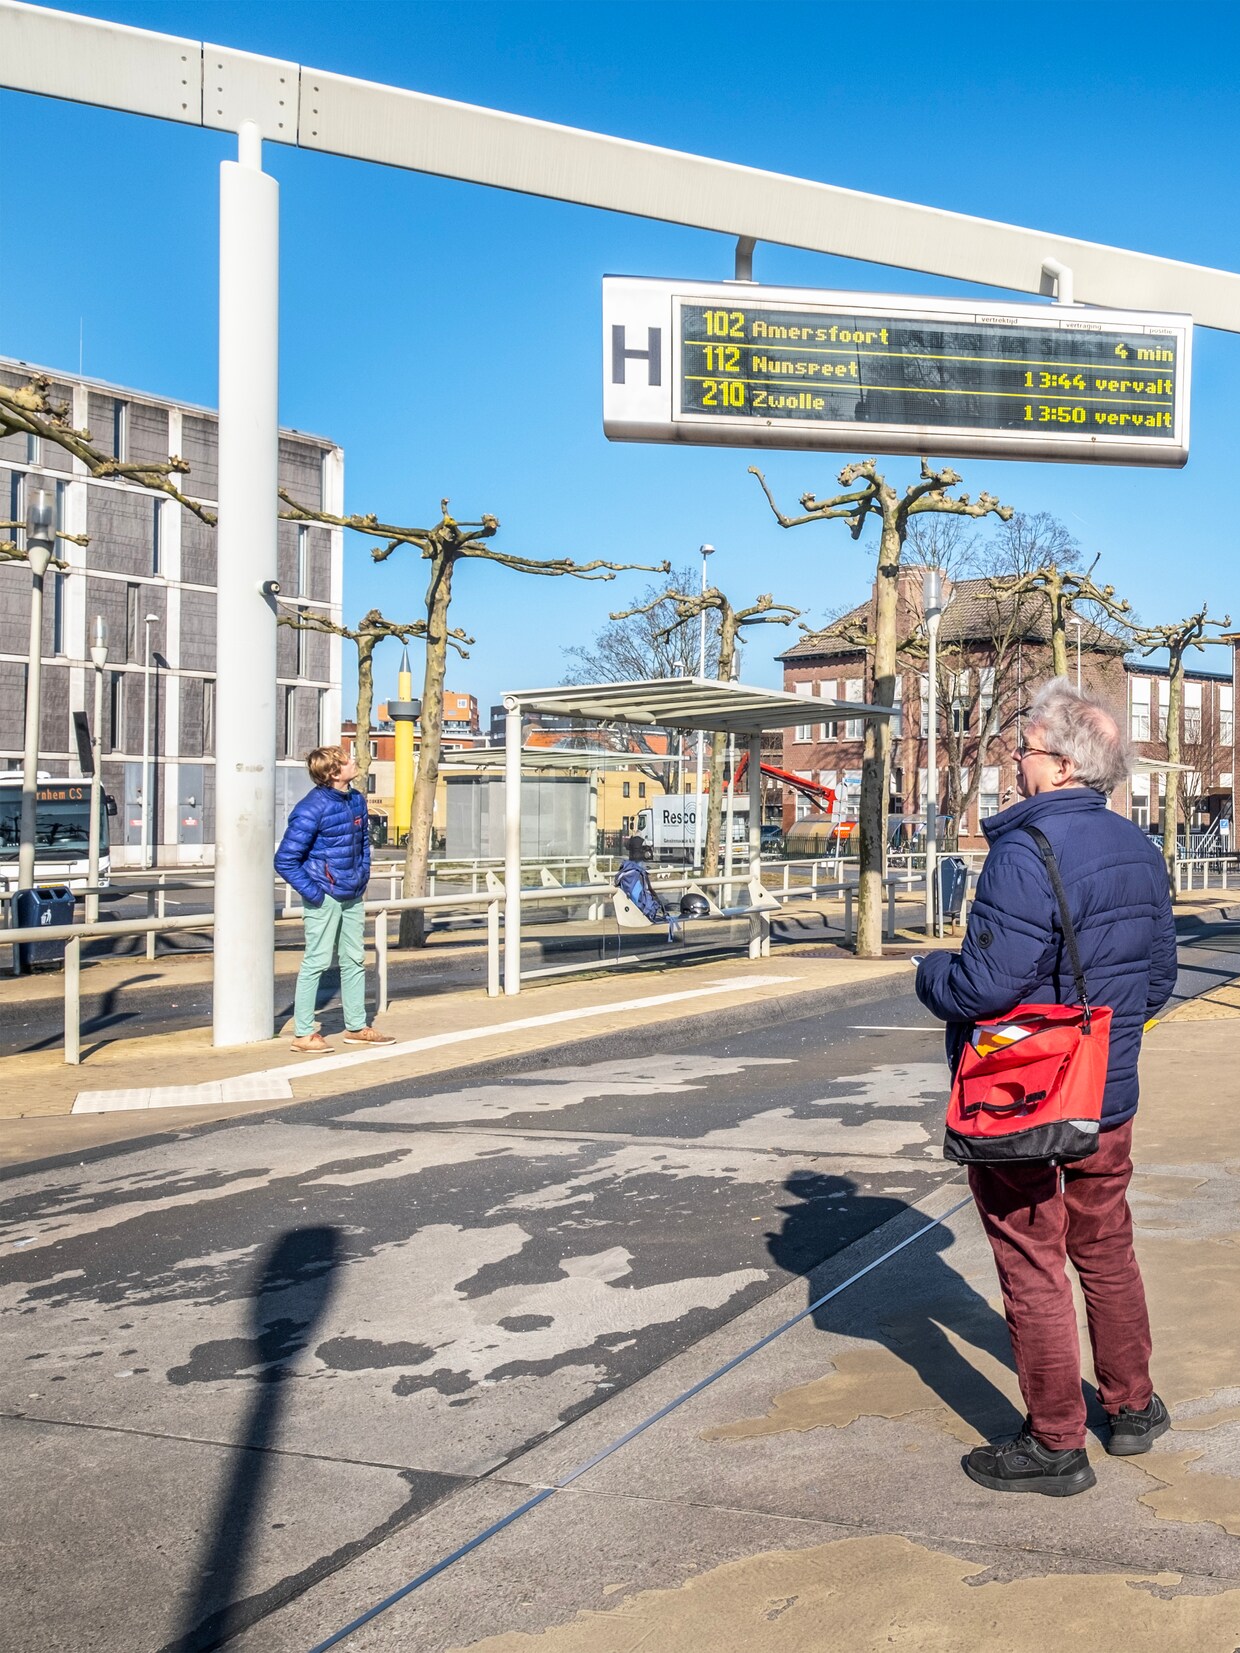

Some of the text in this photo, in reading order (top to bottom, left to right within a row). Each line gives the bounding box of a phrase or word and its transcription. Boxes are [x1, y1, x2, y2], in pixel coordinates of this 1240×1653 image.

[703, 310, 1174, 362] 102 Amersfoort 4 min
[981, 316, 1018, 325] vertrektijd
[1065, 321, 1102, 331] vertraging
[612, 325, 661, 386] H
[703, 345, 1174, 396] 112 Nunspeet 13:44 vervalt
[702, 381, 1173, 429] 210 Zwolle 13:50 vervalt
[36, 788, 83, 800] rnhem CS
